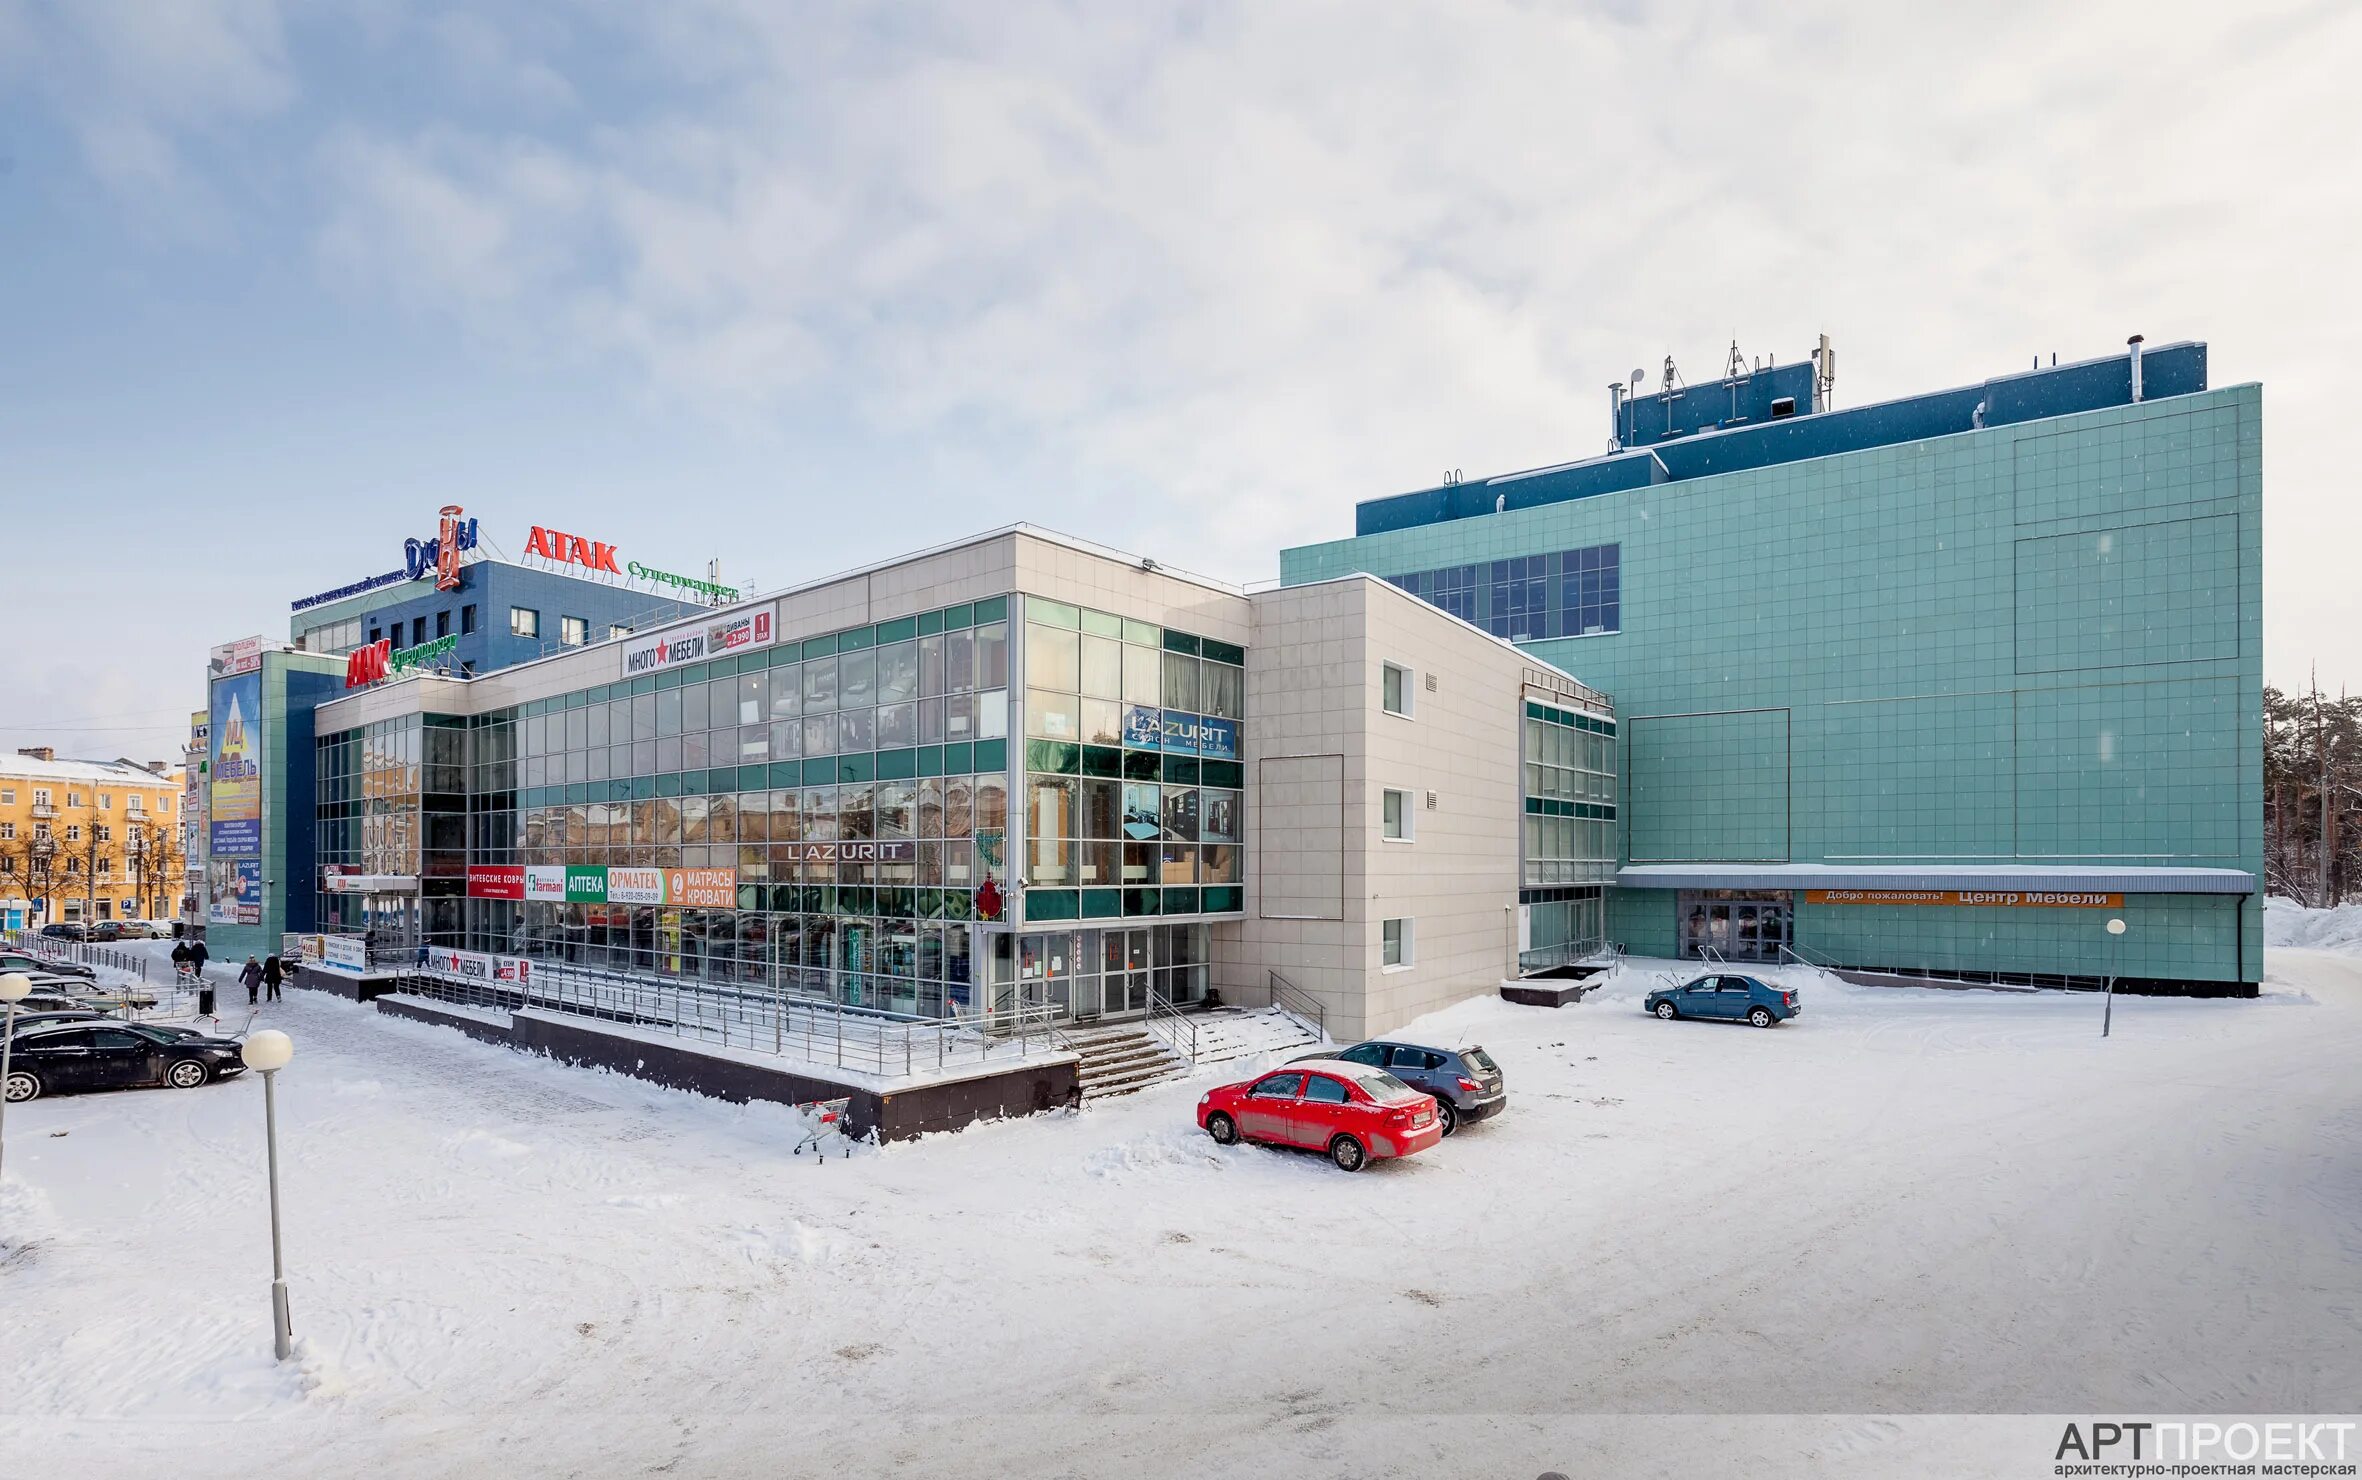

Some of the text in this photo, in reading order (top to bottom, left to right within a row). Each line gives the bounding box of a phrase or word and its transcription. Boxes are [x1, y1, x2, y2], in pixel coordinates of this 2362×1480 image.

[524, 525, 622, 575] АТАК
[627, 561, 739, 598] Супермаркет
[726, 617, 750, 633] ДИВАНЫ
[759, 615, 765, 632] 1
[732, 630, 750, 646] 2.990
[756, 632, 769, 641] ЭТАЖ
[628, 649, 656, 672] МНОГО
[668, 635, 704, 663] МЕБЕЛИ
[1131, 715, 1228, 742] LAZURIT
[216, 759, 257, 779] МЕБЕЛЬ
[788, 843, 902, 860] LAZURIT
[469, 874, 501, 883] ВИТЕБСКИЕ
[536, 878, 563, 893] farmani
[568, 876, 604, 892] АПТЕКА
[609, 871, 658, 889] ОРМАТЕК
[687, 871, 733, 887] МАТРАСЫ
[687, 888, 733, 905] КРОВАТИ
[1826, 891, 2107, 905] Добро пожаловать! Центр Мебели
[460, 959, 486, 978] МЕБЕЛИ
